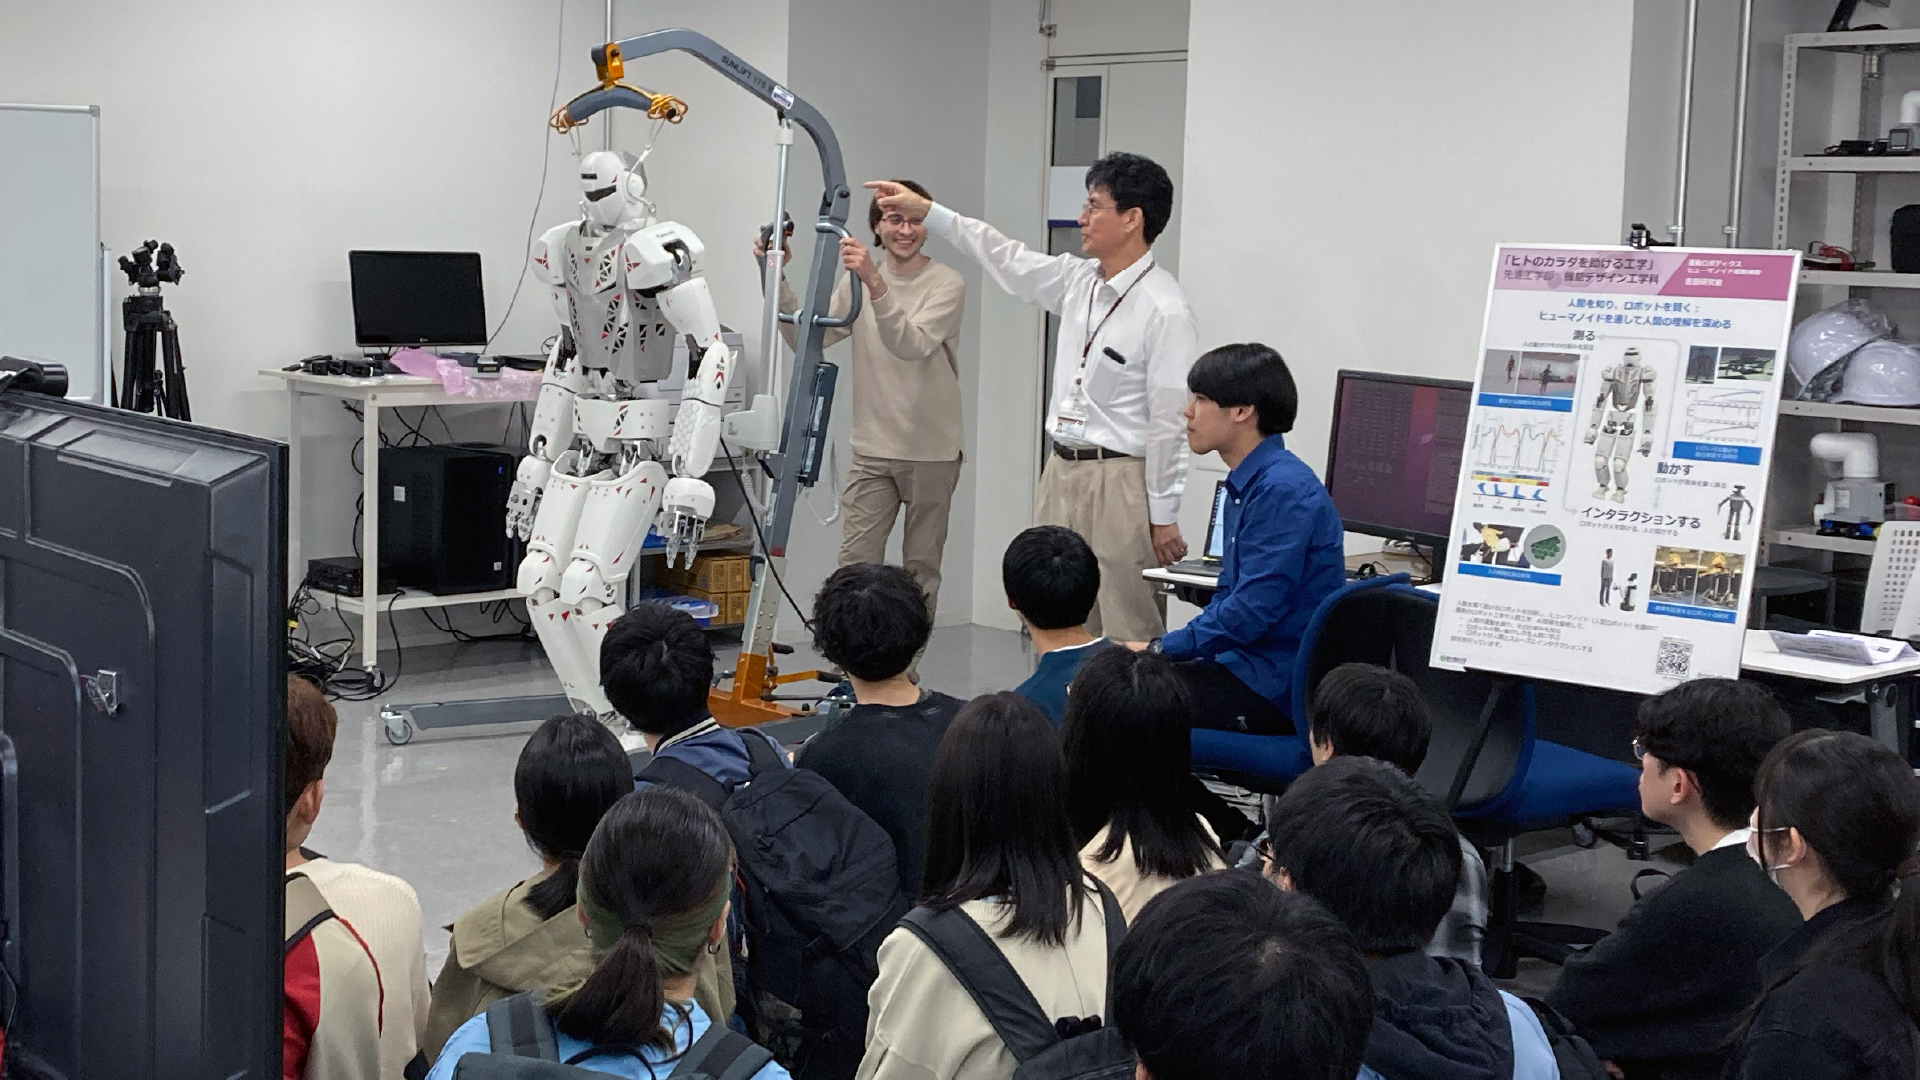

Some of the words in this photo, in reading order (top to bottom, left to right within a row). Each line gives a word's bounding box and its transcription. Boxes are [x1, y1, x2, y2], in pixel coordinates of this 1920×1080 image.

[721, 55, 752, 79] SUNLIFT
[1504, 254, 1654, 270] 「ヒトのカラダを助ける工学」
[1564, 272, 1660, 285] 機能デザイン工学科
[1539, 310, 1732, 329] ヒューマノイドを通して人間の理解を深める
[1572, 329, 1595, 341] 測る
[1657, 461, 1694, 476] 動かす
[1581, 507, 1701, 529] インタラクションする
